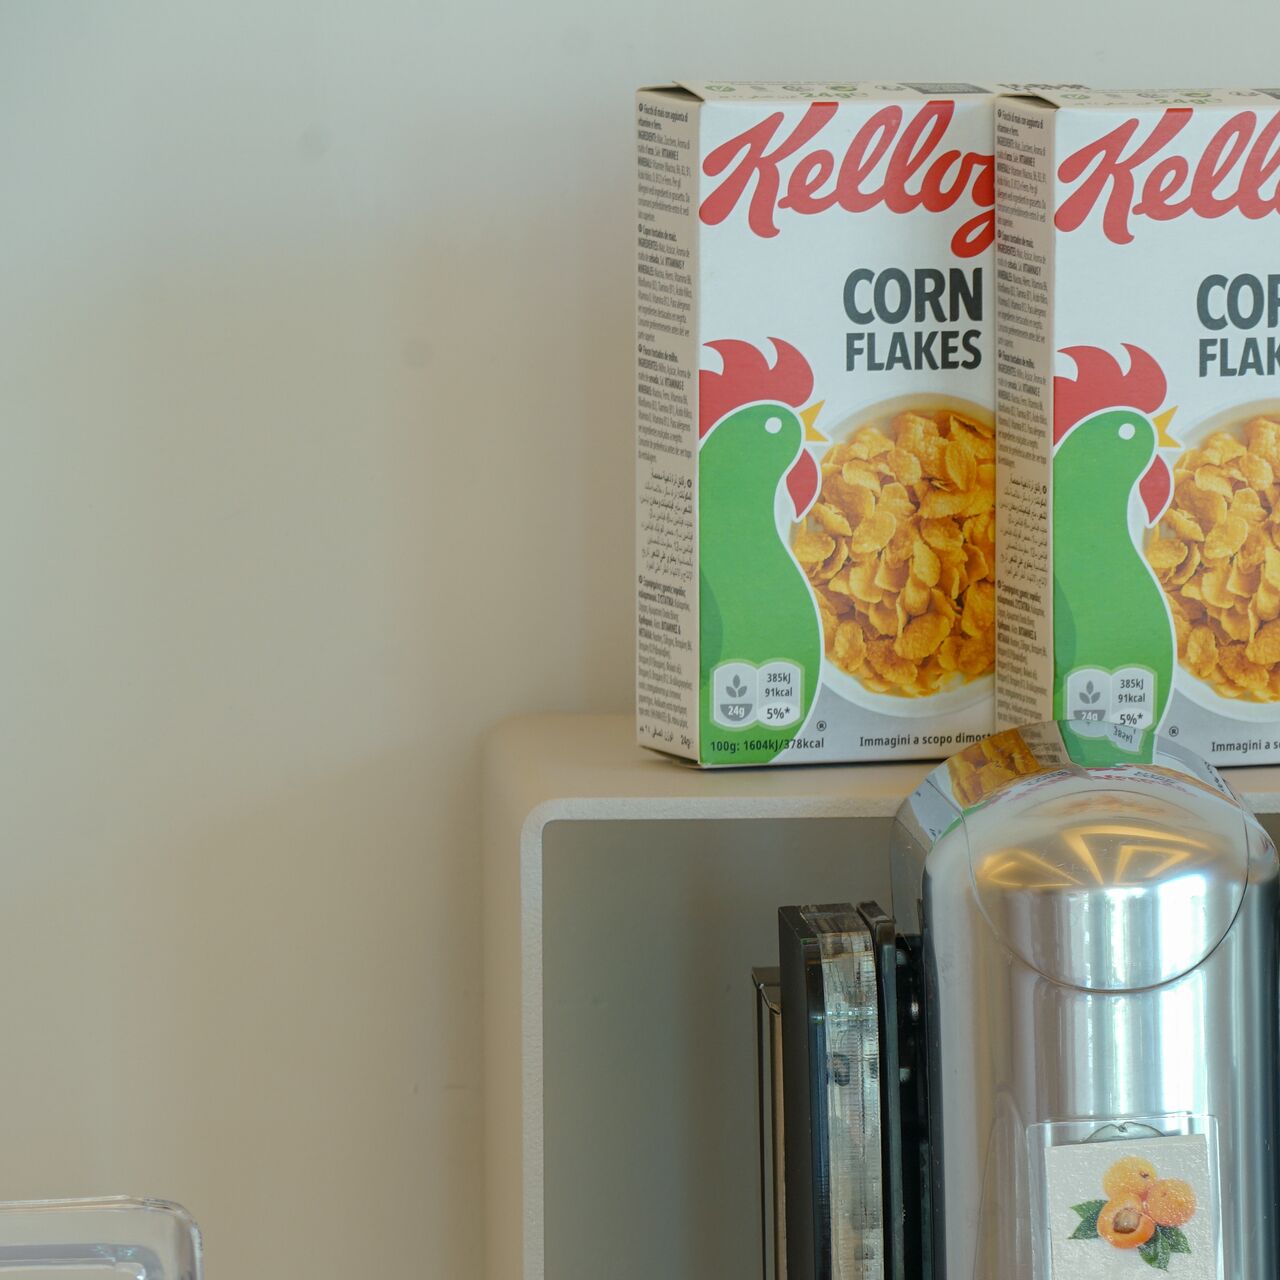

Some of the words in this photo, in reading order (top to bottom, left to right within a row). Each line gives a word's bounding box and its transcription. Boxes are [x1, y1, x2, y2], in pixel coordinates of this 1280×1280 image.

[699, 100, 995, 258] Kellog
[843, 267, 983, 325] CORN
[845, 329, 982, 372] FLAKES
[766, 672, 791, 684] 385kJ
[1120, 678, 1144, 690] 385kJ
[765, 687, 793, 697] 91kcal
[1118, 693, 1146, 703] 91kcal
[727, 704, 745, 718] 24g
[711, 740, 740, 753] 100g:
[743, 738, 825, 752] 1604kJ/378kcal
[860, 735, 911, 748] Immagini
[921, 734, 950, 747] scopo
[1211, 740, 1262, 754] Immagini
